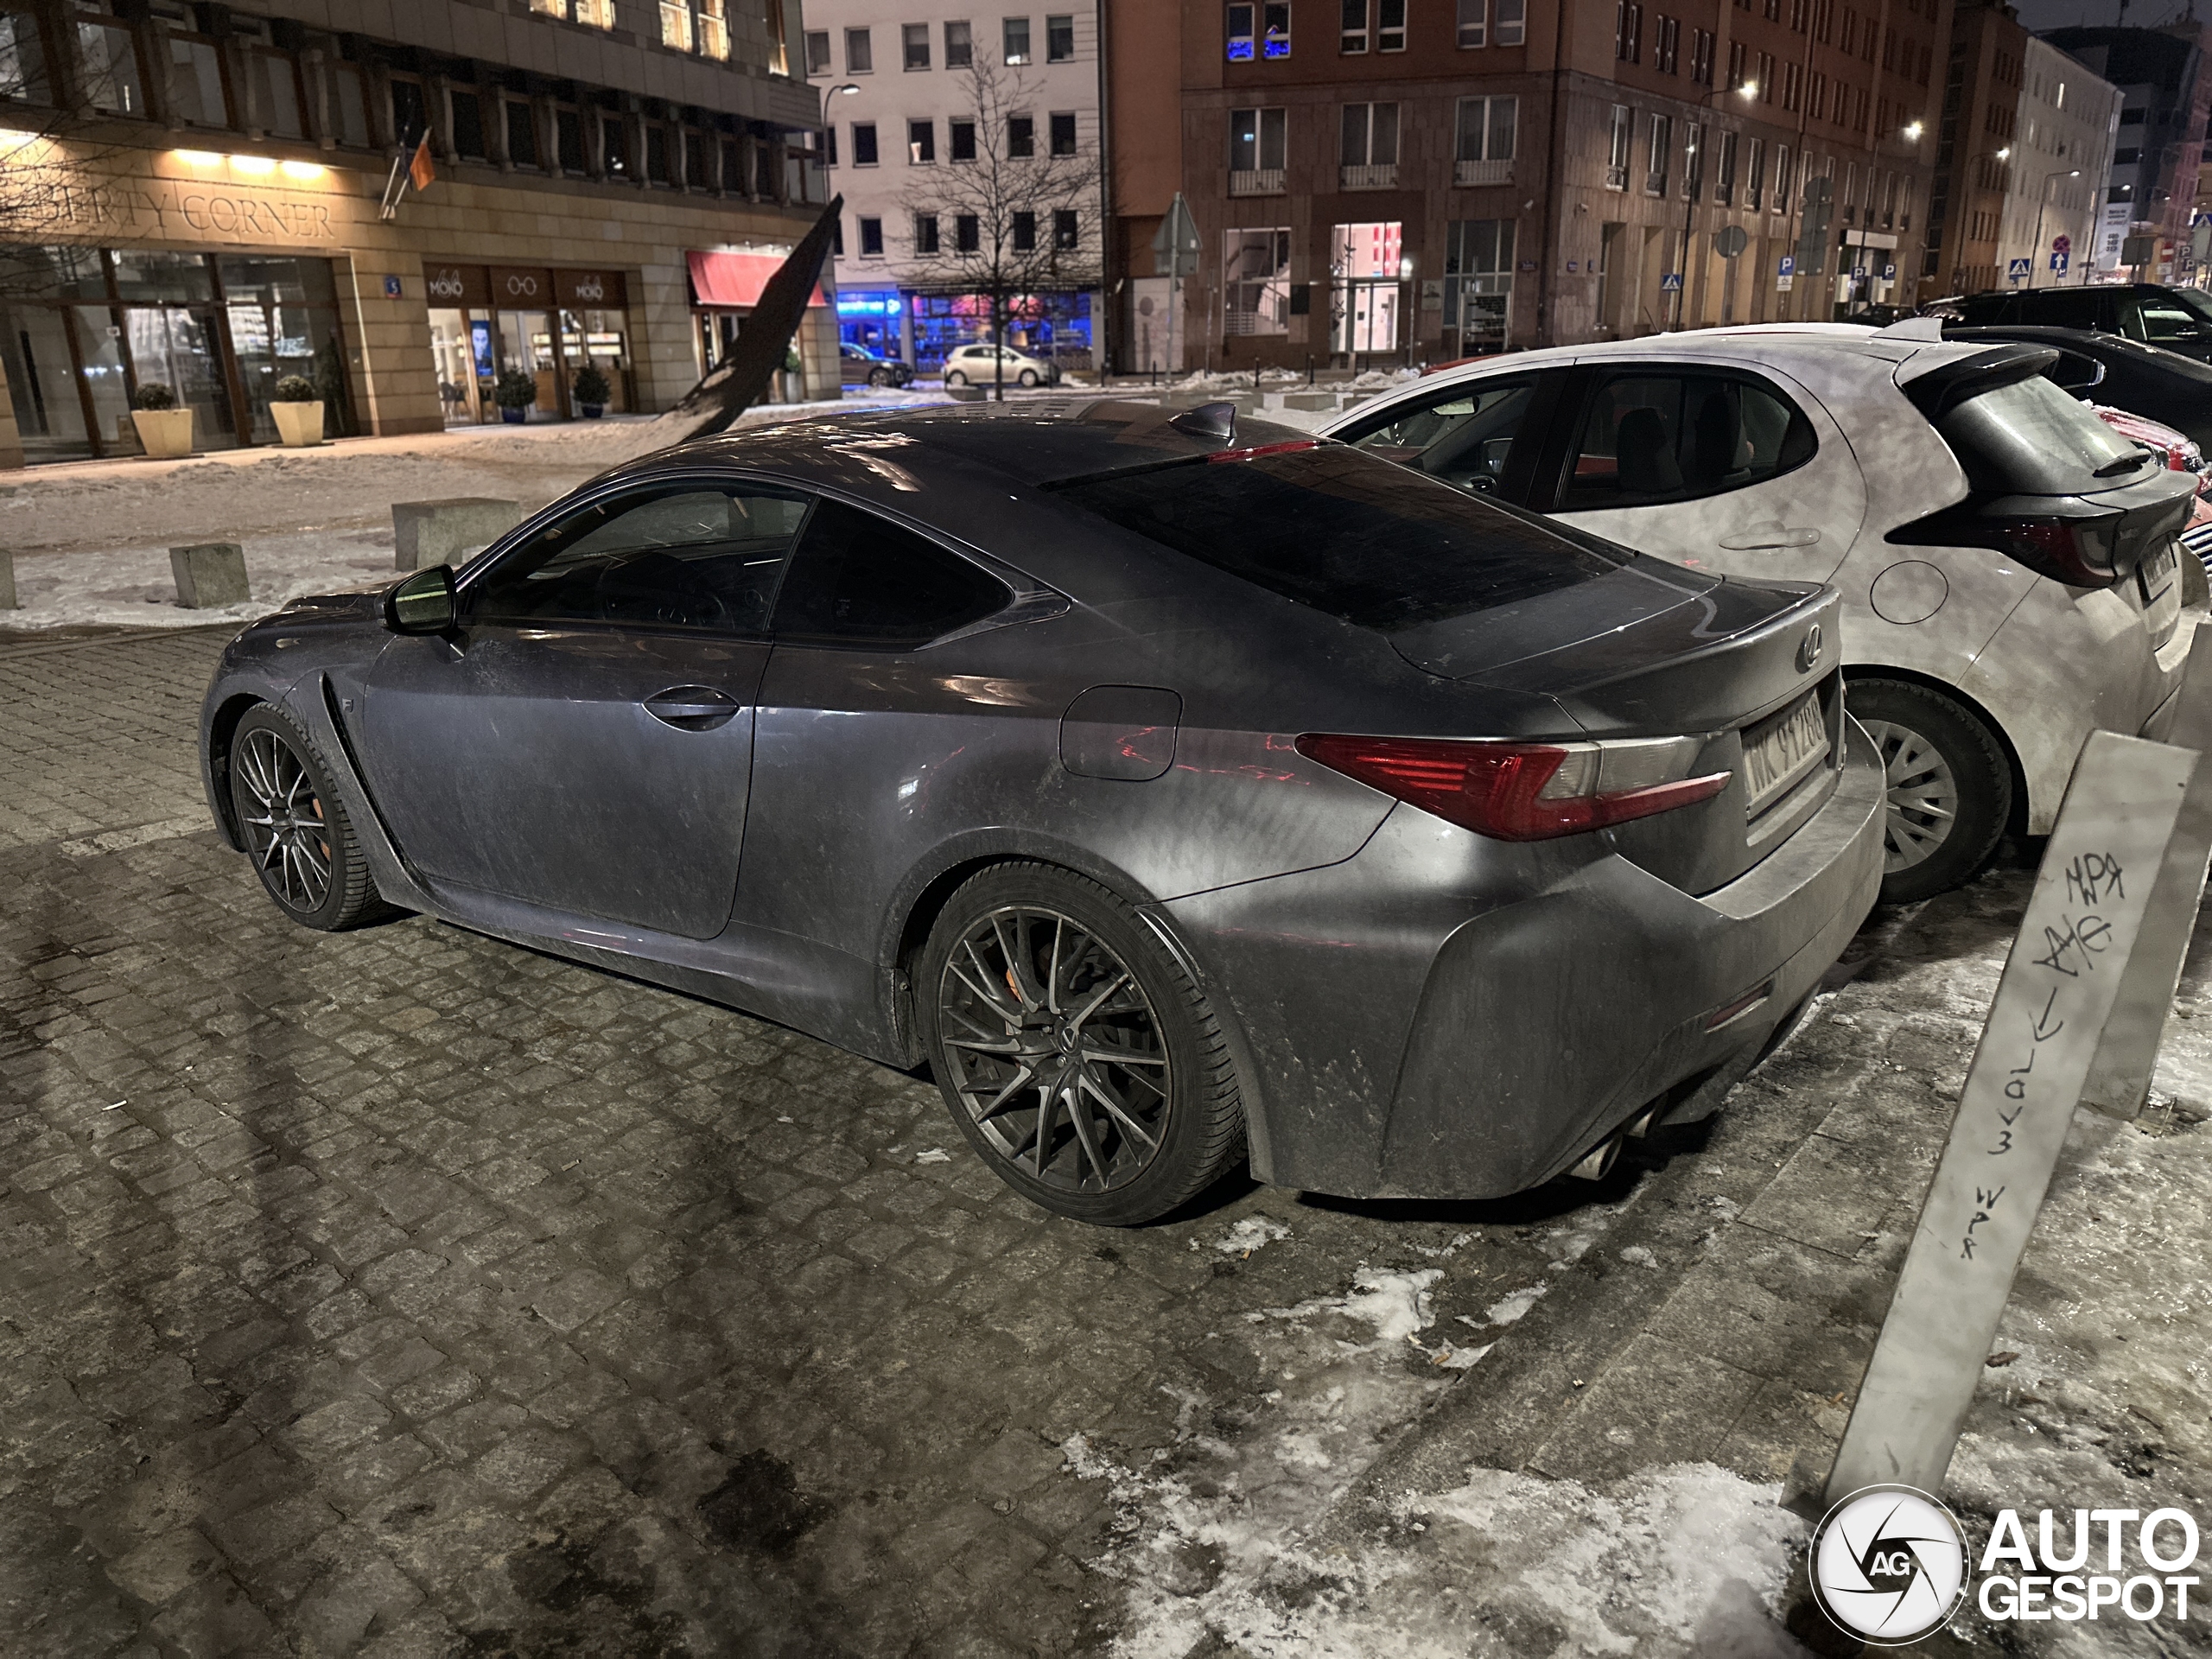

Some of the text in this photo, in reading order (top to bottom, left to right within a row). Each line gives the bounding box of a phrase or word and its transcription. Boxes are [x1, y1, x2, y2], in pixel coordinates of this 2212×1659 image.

[181, 194, 335, 238] CORNER
[1782, 257, 1792, 270] P
[1853, 267, 1864, 279] P
[1885, 264, 1895, 276] P
